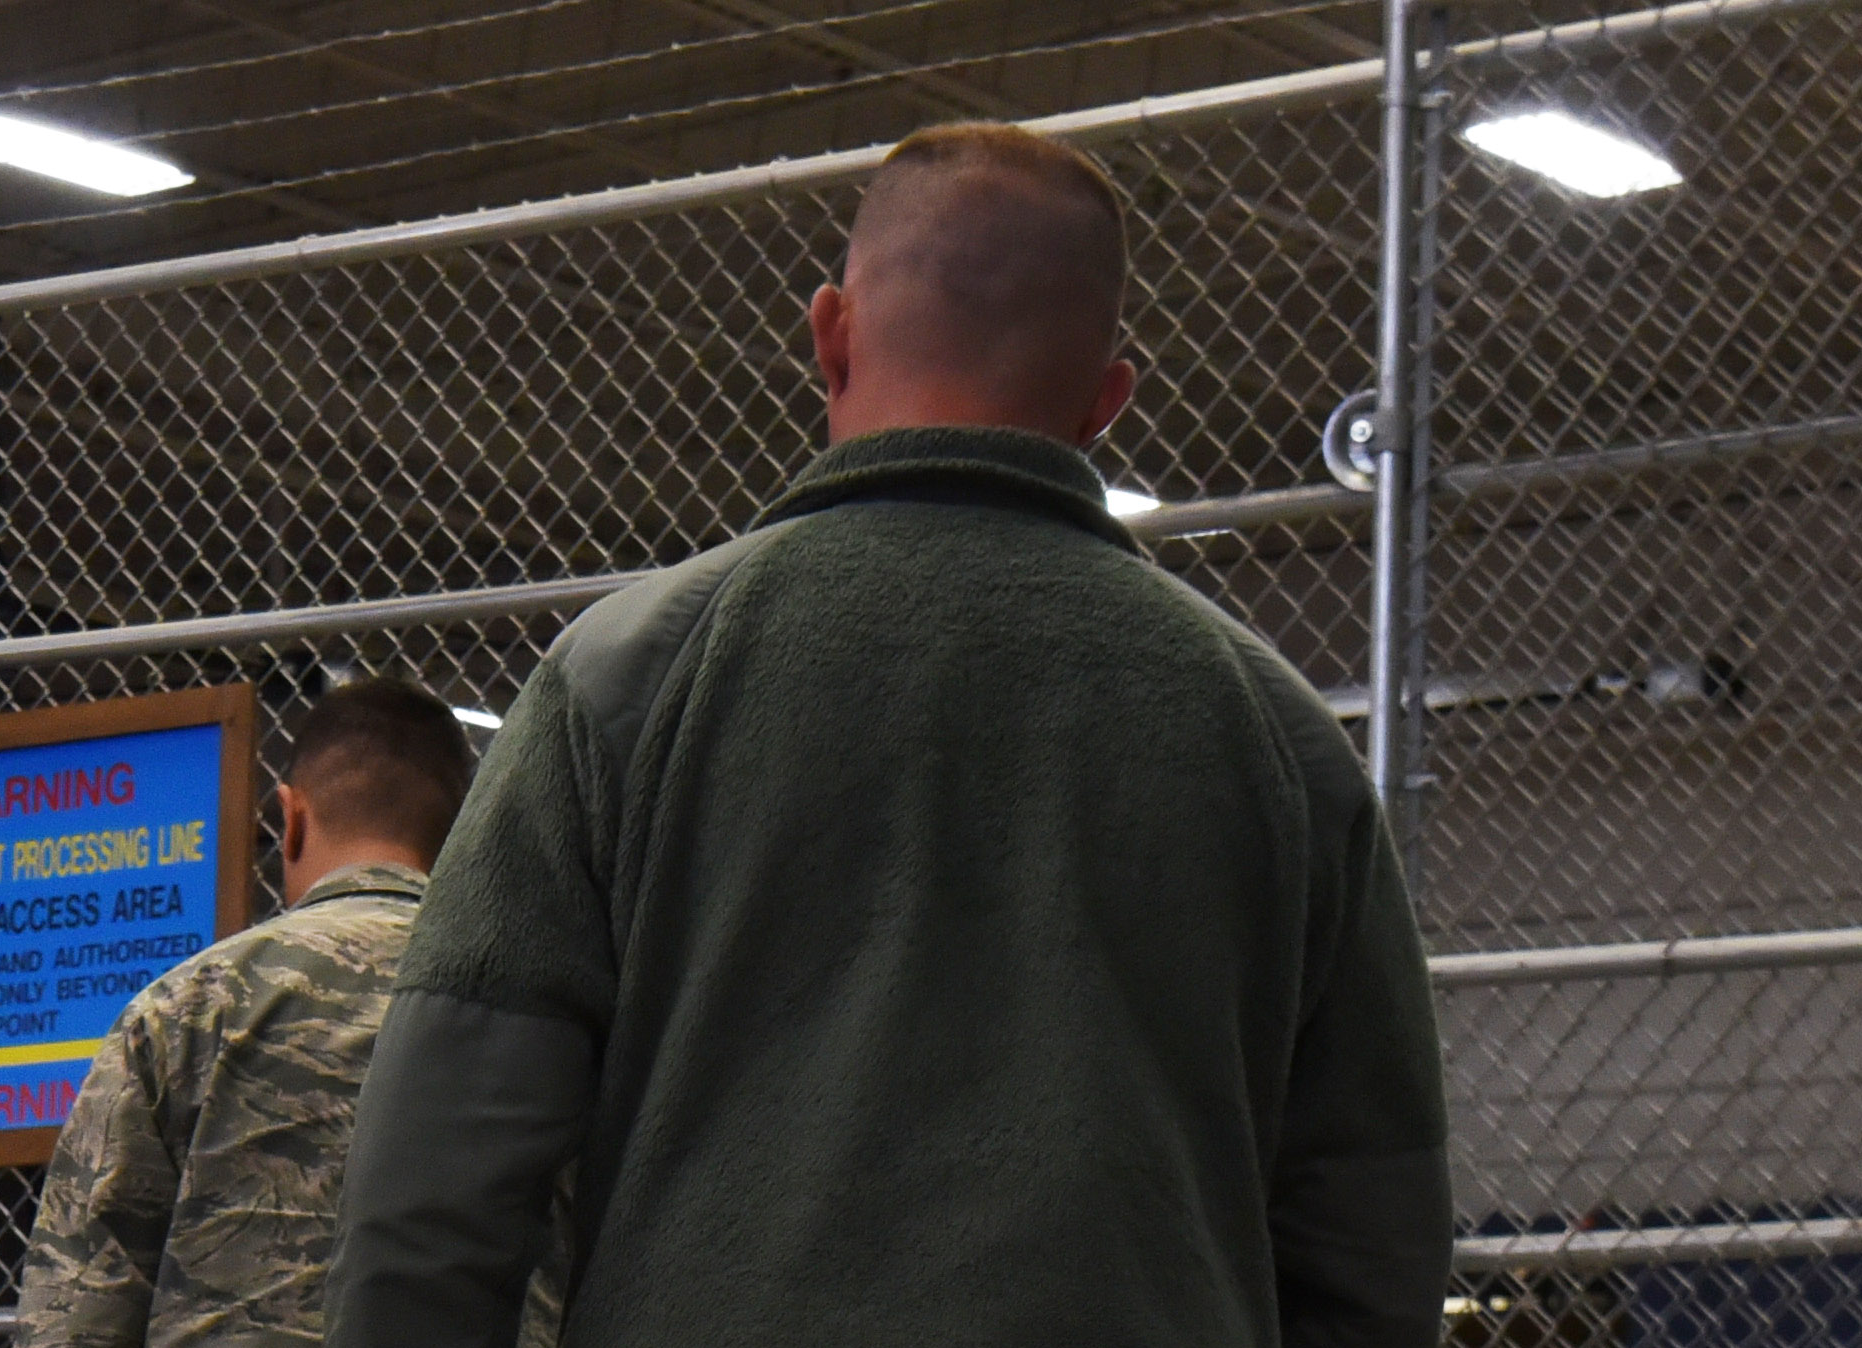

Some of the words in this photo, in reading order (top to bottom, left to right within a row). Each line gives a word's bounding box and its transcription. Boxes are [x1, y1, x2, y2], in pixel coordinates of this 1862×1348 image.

[12, 826, 149, 881] PROCESSING
[157, 820, 205, 866] LINE
[112, 884, 183, 923] AREA
[53, 932, 203, 970] AUTHORIZED
[57, 970, 153, 1002] BEYOND
